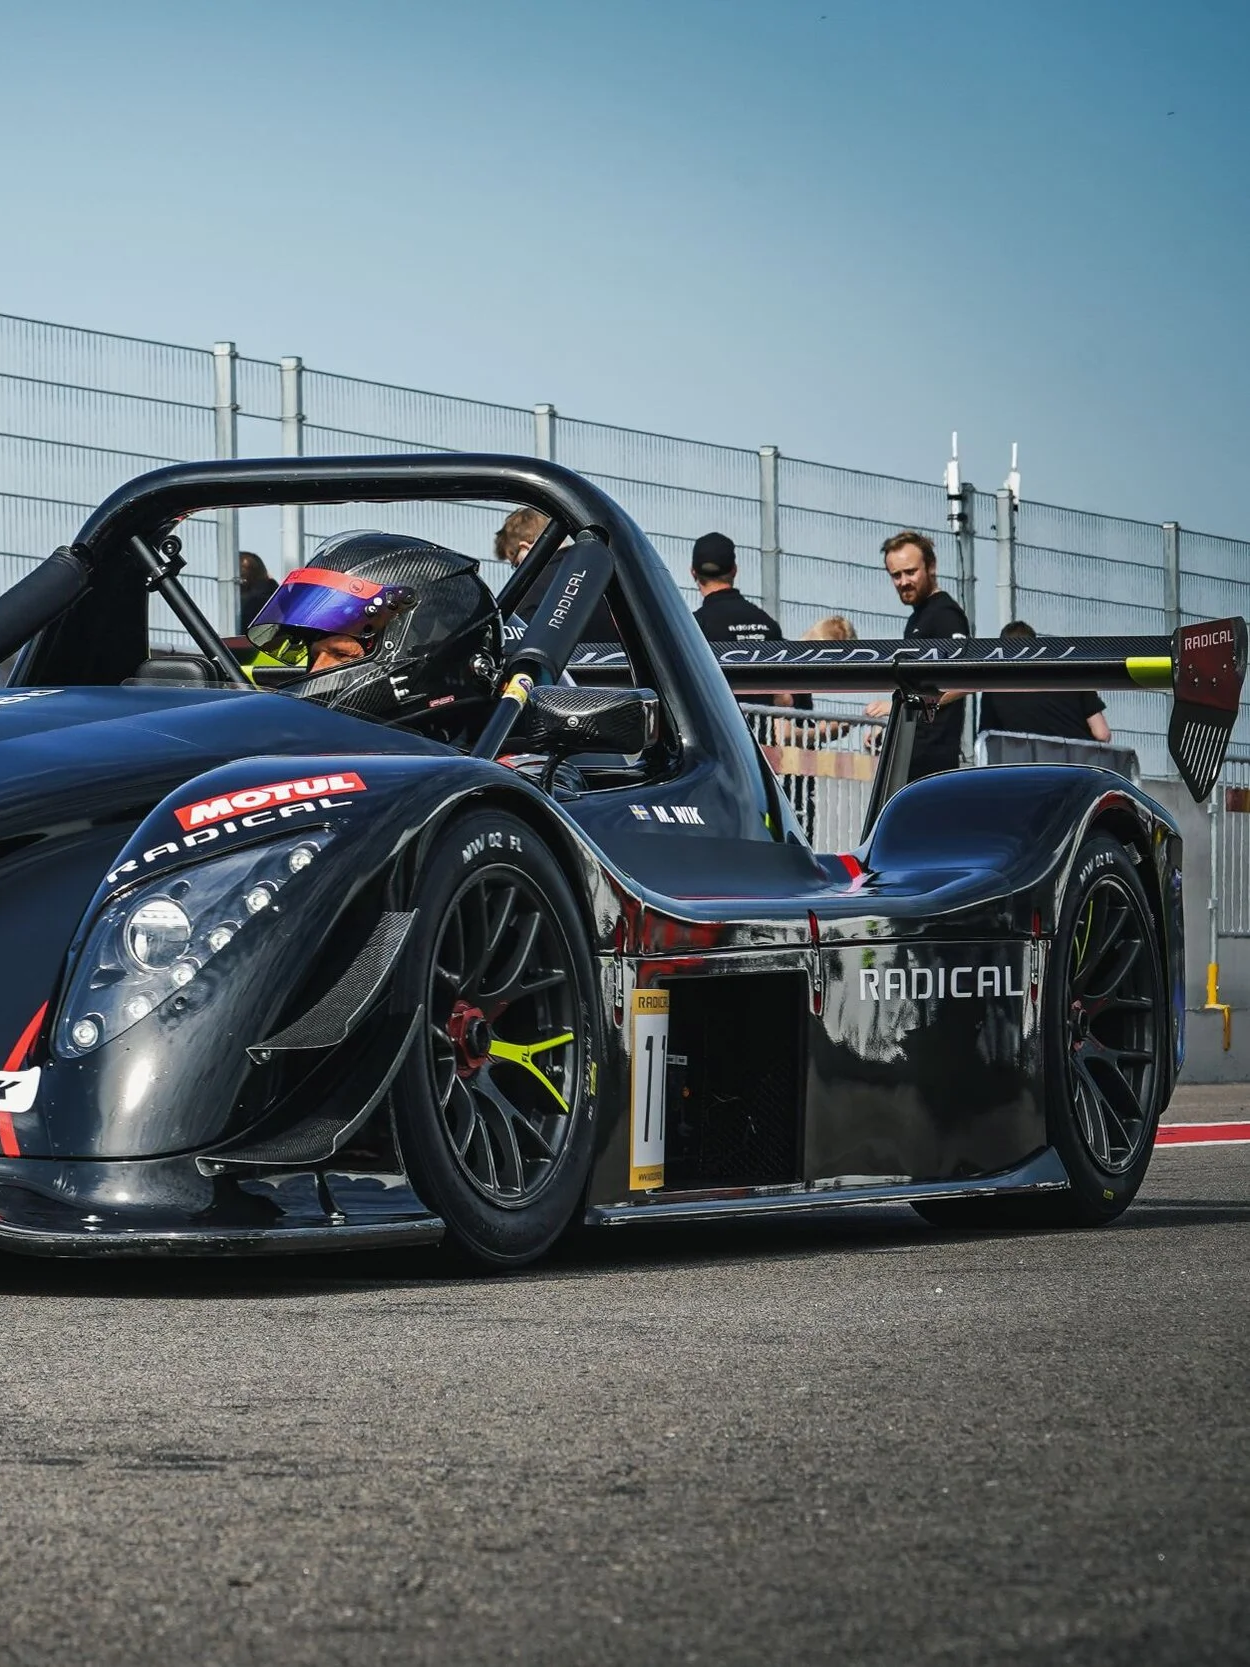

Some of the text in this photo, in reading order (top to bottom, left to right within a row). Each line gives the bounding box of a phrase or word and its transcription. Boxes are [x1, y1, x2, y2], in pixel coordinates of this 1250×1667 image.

[548, 570, 587, 629] RADICAL
[1184, 630, 1234, 651] RADICAL
[189, 776, 356, 826] MOTUL
[651, 805, 706, 825] M. WIK
[106, 798, 353, 883] RADICAL
[859, 965, 1024, 1001] RADICAL
